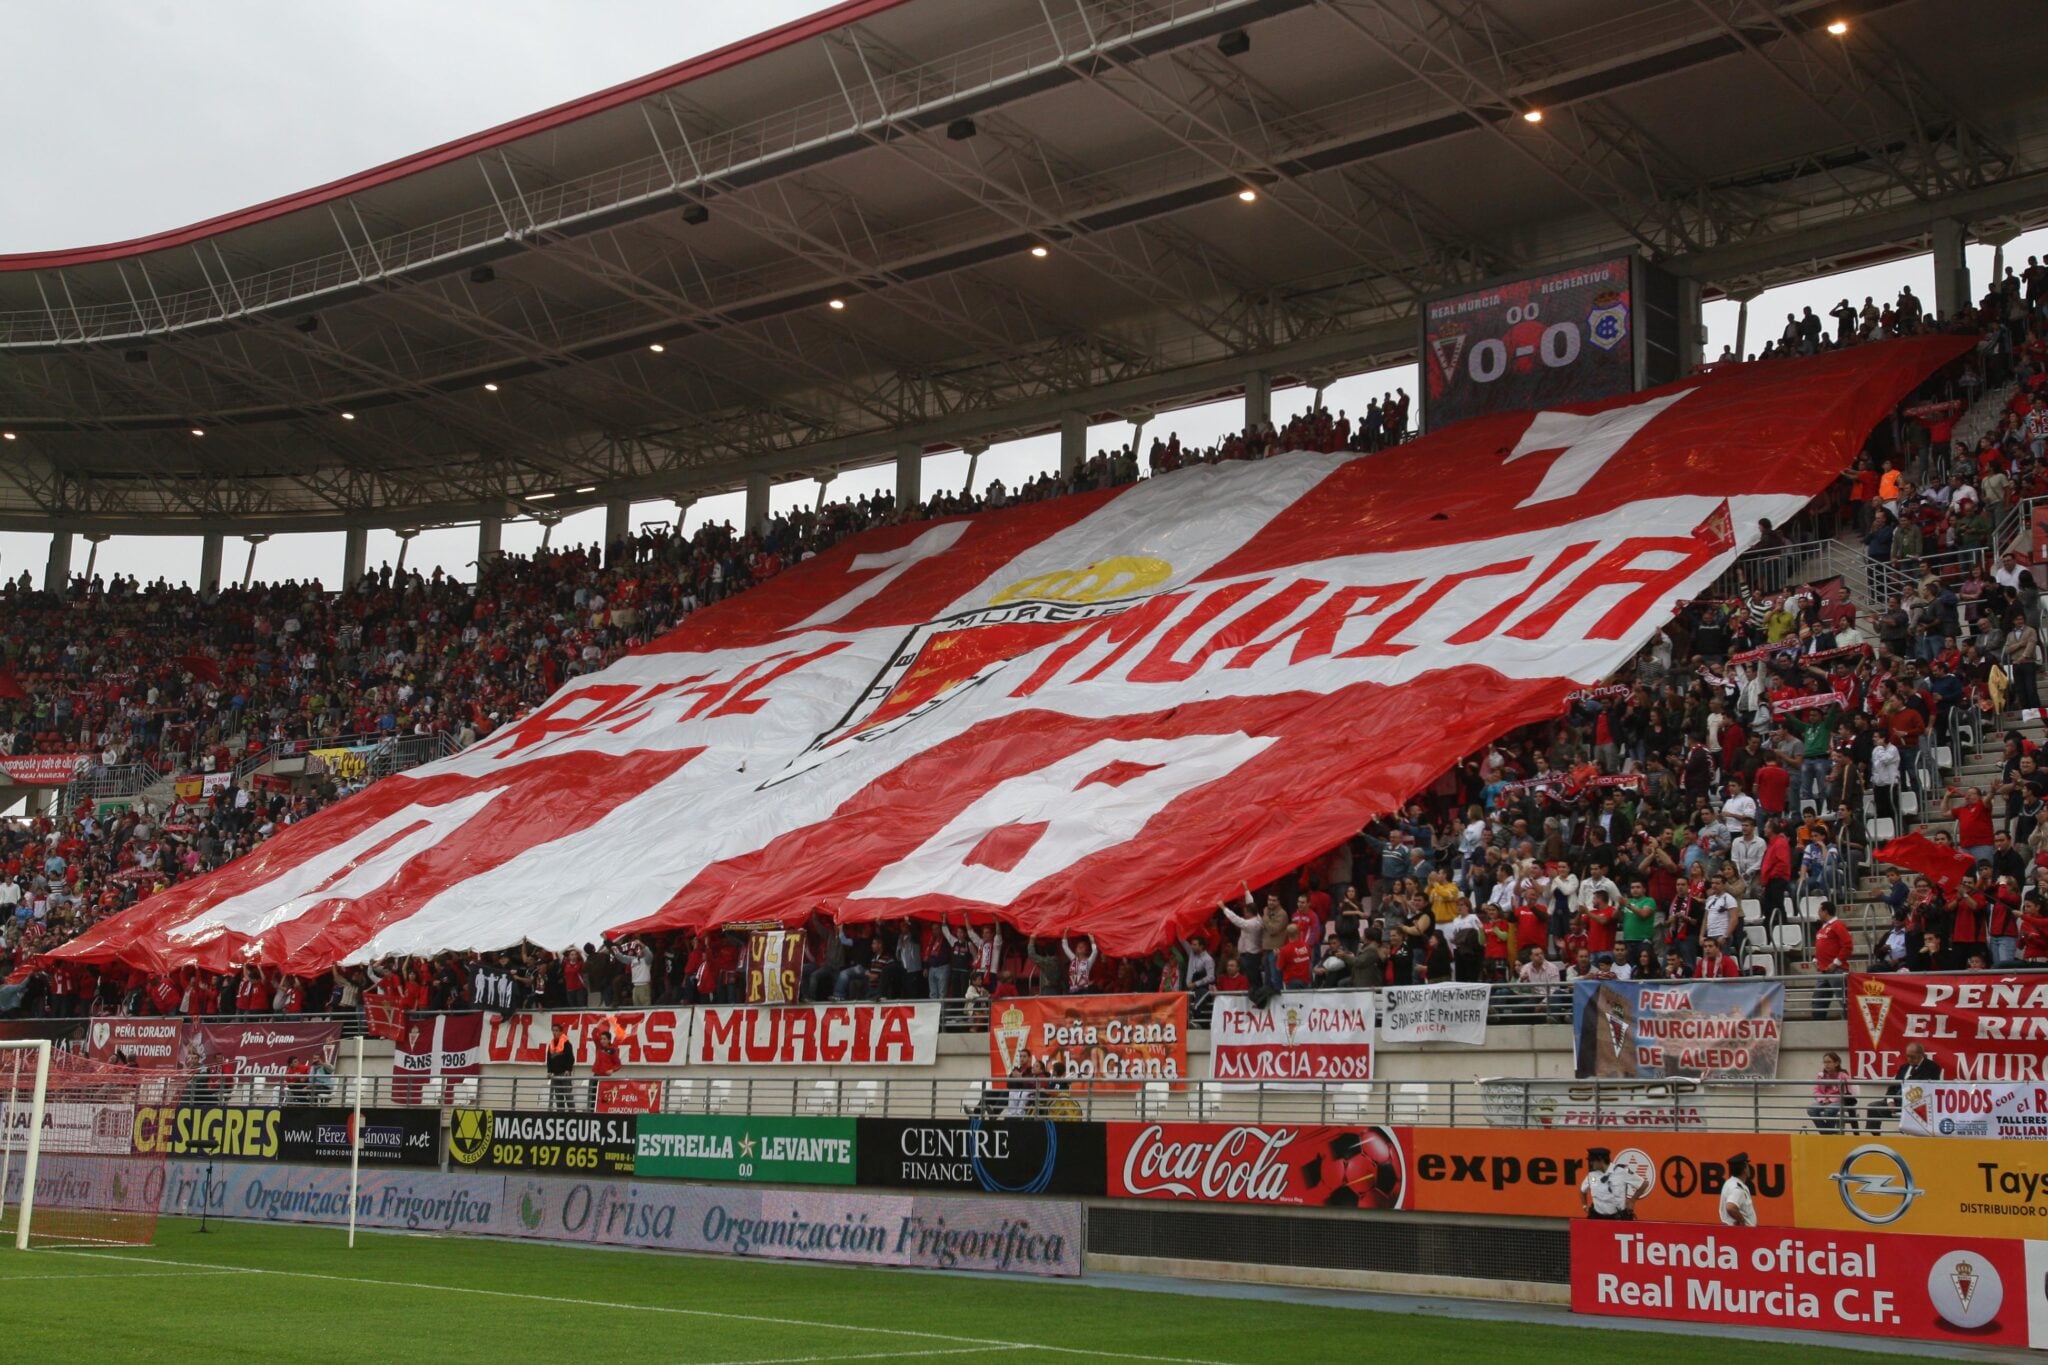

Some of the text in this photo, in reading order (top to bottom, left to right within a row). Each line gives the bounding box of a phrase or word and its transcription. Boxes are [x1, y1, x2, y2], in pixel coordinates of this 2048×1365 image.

[1542, 270, 1610, 294] RECREATIVO
[1432, 294, 1500, 320] REAL MURCIA
[1639, 990, 1692, 1011] PEÑA
[1921, 977, 2048, 1010] PEÑA
[1308, 1008, 1366, 1033] GRANA
[1439, 1009, 1481, 1023] PRIMERA
[1902, 1013, 1957, 1039] EL
[115, 1022, 176, 1039] PEÑA CORAZON
[240, 1031, 295, 1048] Peña Grana
[702, 1006, 915, 1062] MURCIA
[1043, 1019, 1177, 1046] Peña Grana
[1638, 1019, 1777, 1040] MURCIANISTA
[403, 1052, 466, 1070] FANS 1908
[1103, 1053, 1178, 1079] Grana
[1219, 1051, 1368, 1078] MURCIA 2008
[1639, 1047, 1749, 1069] DE ALEDO
[1934, 1088, 1993, 1114] TODOS
[1995, 1091, 2016, 1108] con
[2016, 1098, 2030, 1113] el
[134, 1107, 281, 1158] CESIGRES
[1996, 1115, 2048, 1125] TALLERES
[1998, 1125, 2048, 1137] JULIAN
[318, 1125, 346, 1143] Pérez
[901, 1127, 1010, 1159] CENTRE
[493, 1144, 598, 1168] 902 197 665
[638, 1135, 851, 1164] ESTRELLA LEVANTE
[902, 1162, 974, 1182] FINANCE
[1123, 1125, 1298, 1201] Coca-Cola
[1417, 1152, 1584, 1191] exper
[246, 1178, 373, 1220] Organización
[379, 1184, 491, 1229] Frigorífica
[563, 1184, 676, 1241] Ofrisa
[703, 1205, 887, 1255] Organización
[896, 1215, 1065, 1268] Frigorífica
[1960, 1203, 2036, 1217] DISTRIBUIDOR
[1614, 1233, 1877, 1279] Tienda oficial
[1597, 1273, 1902, 1326] Real Murcia C.F.
